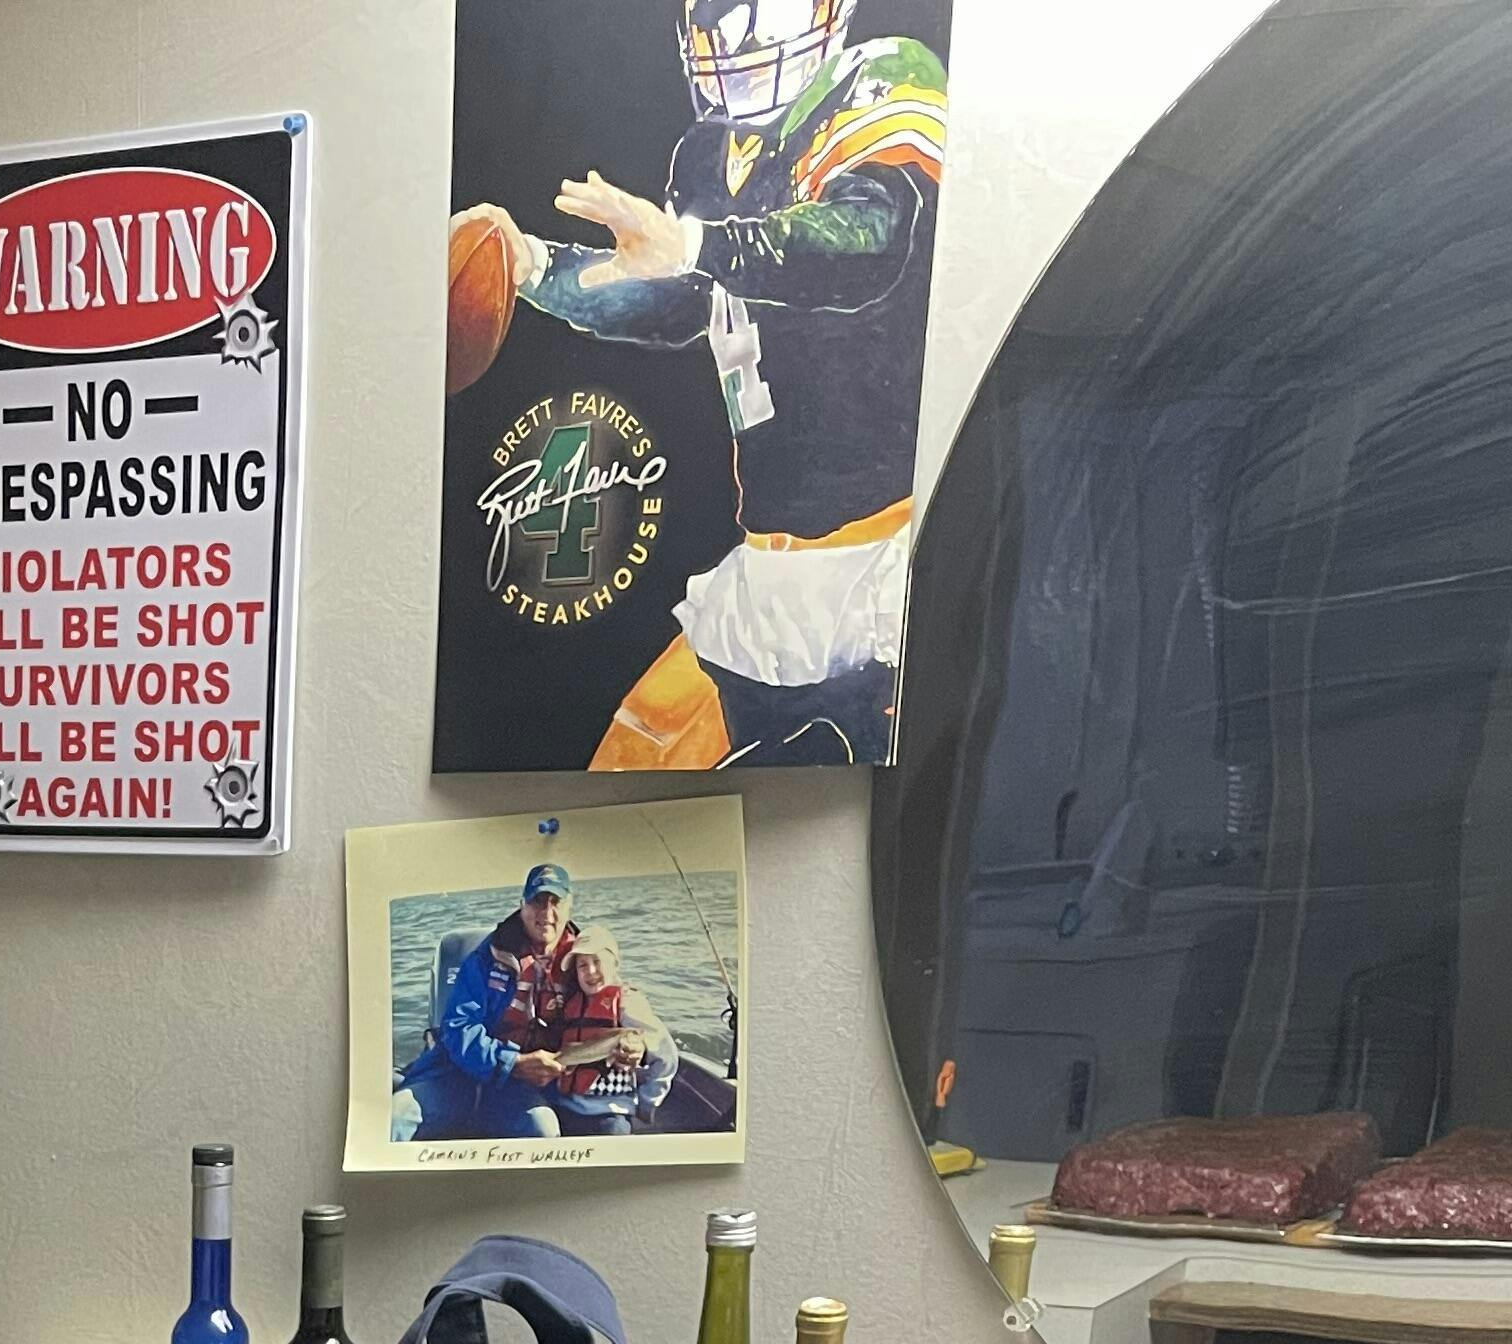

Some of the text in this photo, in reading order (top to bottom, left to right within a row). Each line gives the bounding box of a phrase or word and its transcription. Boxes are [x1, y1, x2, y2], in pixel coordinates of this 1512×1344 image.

[67, 379, 132, 442] NO
[492, 391, 652, 467] BRETT FAVRE'S
[501, 497, 663, 625] STEAKHOUSE
[63, 605, 119, 649] BE
[136, 602, 265, 649] SHOT
[61, 720, 117, 763] BE
[133, 718, 261, 763] SHOT
[17, 777, 173, 819] AGAIN!
